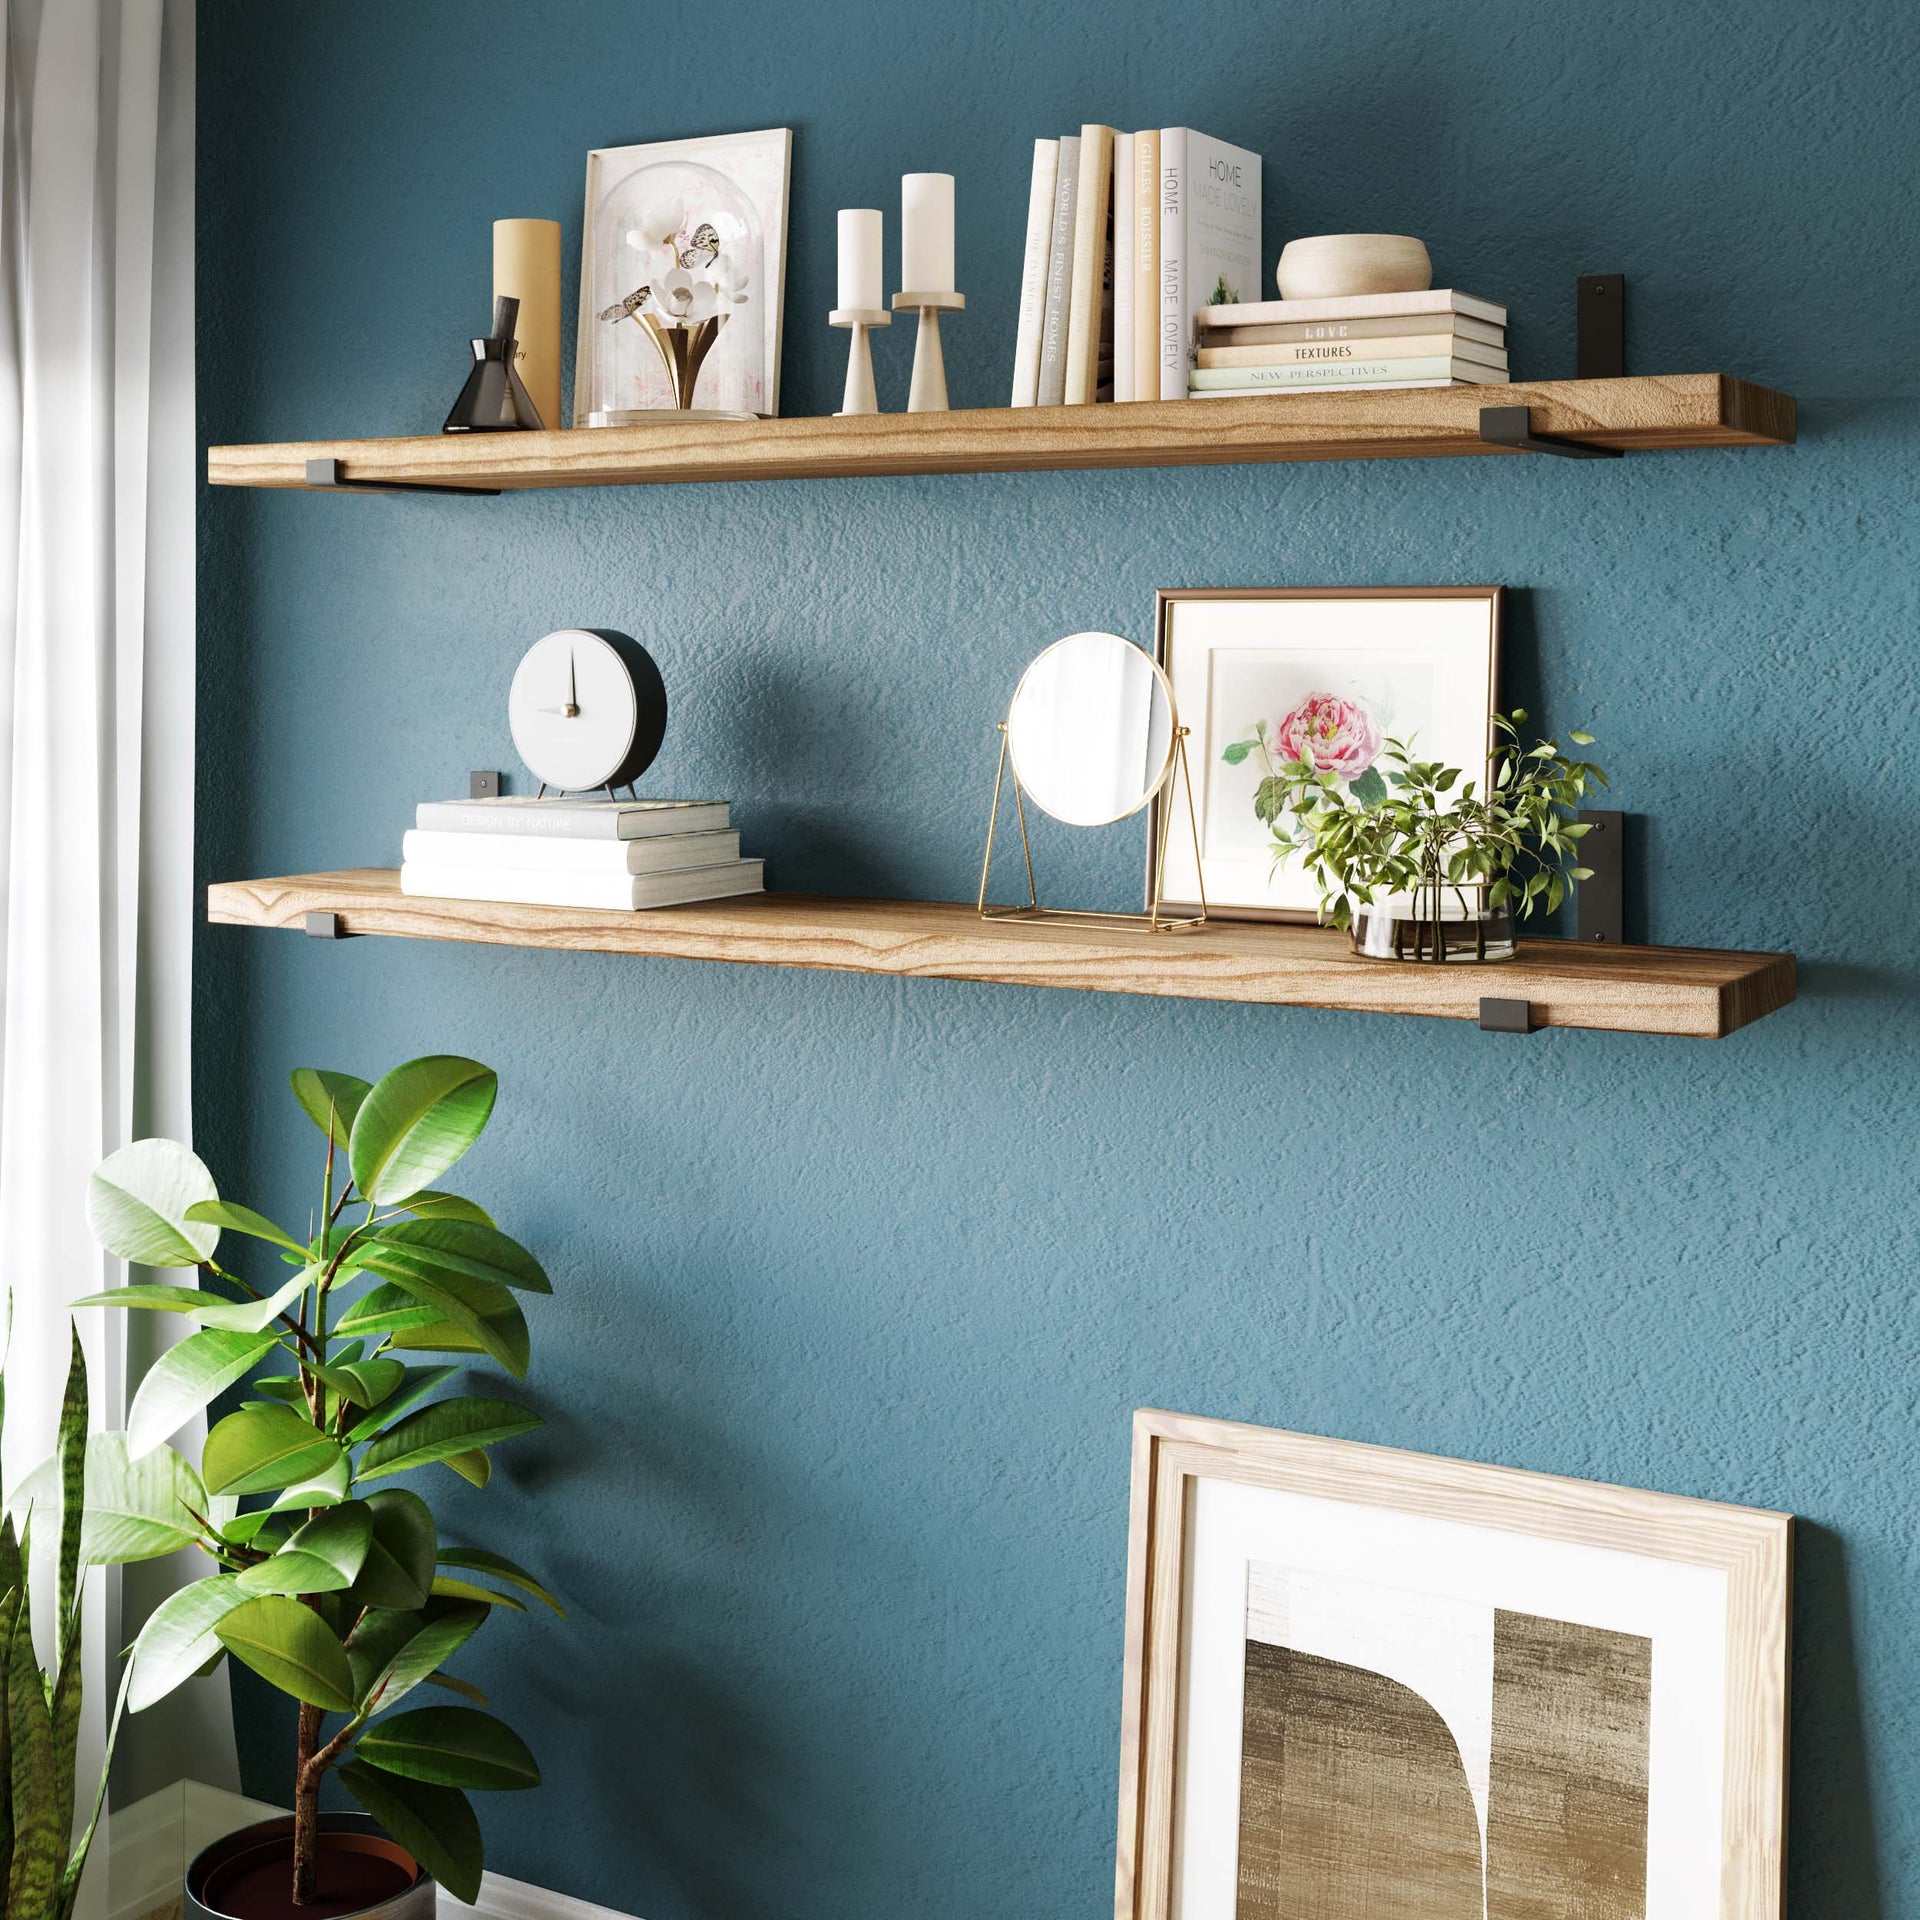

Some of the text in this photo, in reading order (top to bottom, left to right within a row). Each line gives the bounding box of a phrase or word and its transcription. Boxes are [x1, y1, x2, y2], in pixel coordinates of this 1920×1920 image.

[1208, 156, 1242, 188] HOME
[1140, 143, 1152, 272] GILLES BOISSIER
[1192, 179, 1258, 218] MADE LOVELY
[1047, 177, 1072, 362] WORLD'S FINEST HOMES
[1163, 167, 1179, 370] HOME MADE LOVELY
[1305, 325, 1348, 339] LOVE
[1295, 346, 1352, 359] TEXTURES
[1251, 366, 1388, 381] NEW PERSPECTIVES
